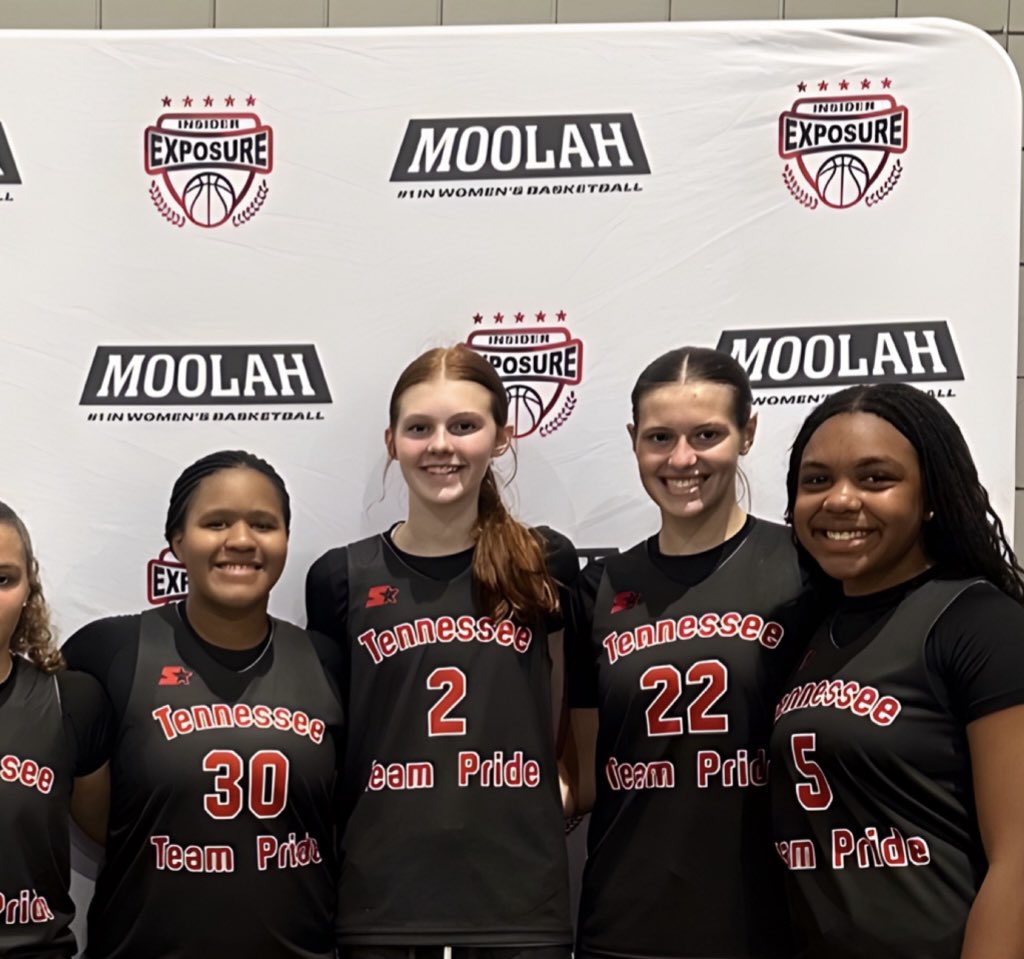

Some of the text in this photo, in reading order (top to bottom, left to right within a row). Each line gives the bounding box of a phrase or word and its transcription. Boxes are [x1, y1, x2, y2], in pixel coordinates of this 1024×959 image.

[150, 132, 267, 167] EXPOSURE
[407, 122, 634, 173] MOOLAH
[785, 112, 903, 152] EXPOSURE
[96, 354, 316, 397] MOOLAH
[482, 346, 576, 378] POSURE
[730, 330, 948, 382] MOOLAH
[358, 615, 533, 664] Tennessee
[602, 612, 785, 664] Tennessee
[427, 666, 467, 737] 2
[640, 659, 729, 737] 22
[152, 704, 326, 745] Tennessee
[202, 749, 290, 820] 30
[366, 751, 541, 792] eam Pride
[695, 749, 772, 789] Prid
[791, 733, 834, 811] 5
[150, 835, 235, 873] Team
[831, 826, 931, 870] Pride
